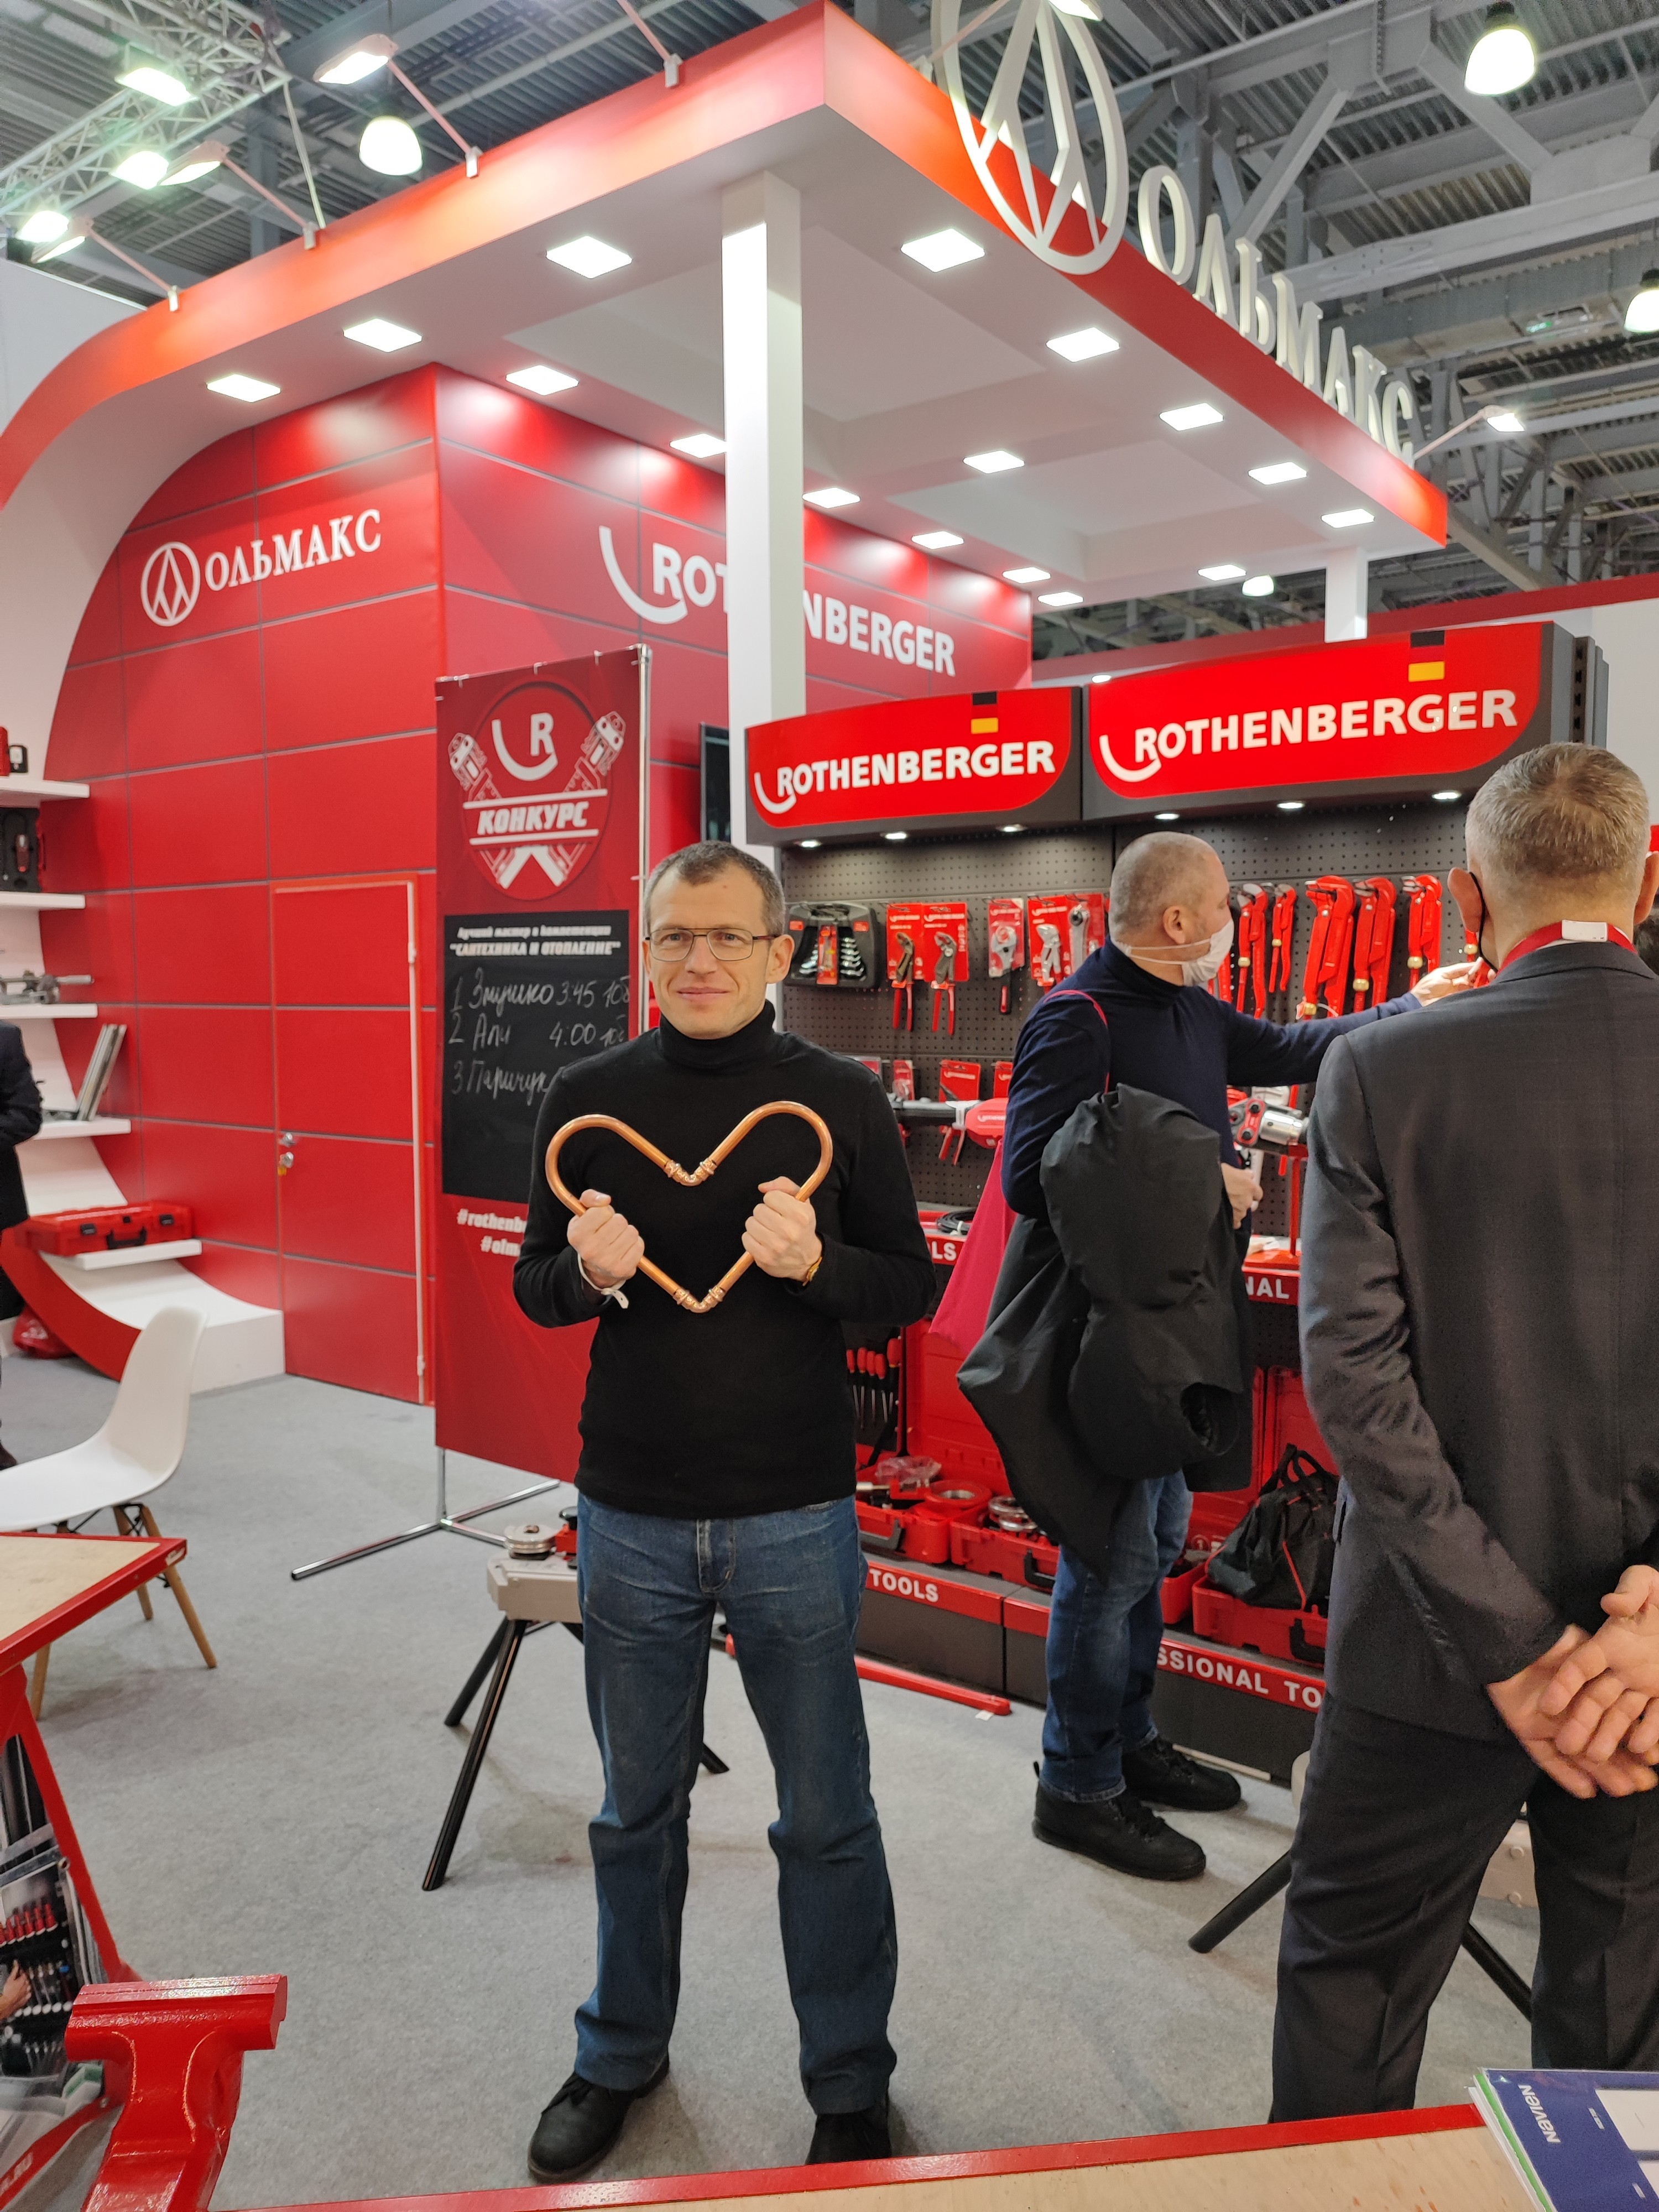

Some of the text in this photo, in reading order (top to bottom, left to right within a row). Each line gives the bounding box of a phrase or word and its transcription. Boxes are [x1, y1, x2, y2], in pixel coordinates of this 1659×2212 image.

[1138, 165, 1415, 468] ОЛЬМАКС
[205, 509, 382, 591] ОЛЬМАКС
[1099, 688, 1518, 783] ROTHENBERGER
[754, 740, 1056, 814] ROTHENBERGER
[477, 801, 589, 836] КОНКУРС
[529, 942, 540, 956] И
[450, 976, 463, 1012] 1
[448, 1012, 464, 1044] 2
[452, 1060, 463, 1095] 3
[869, 1568, 938, 1603] TOOLS
